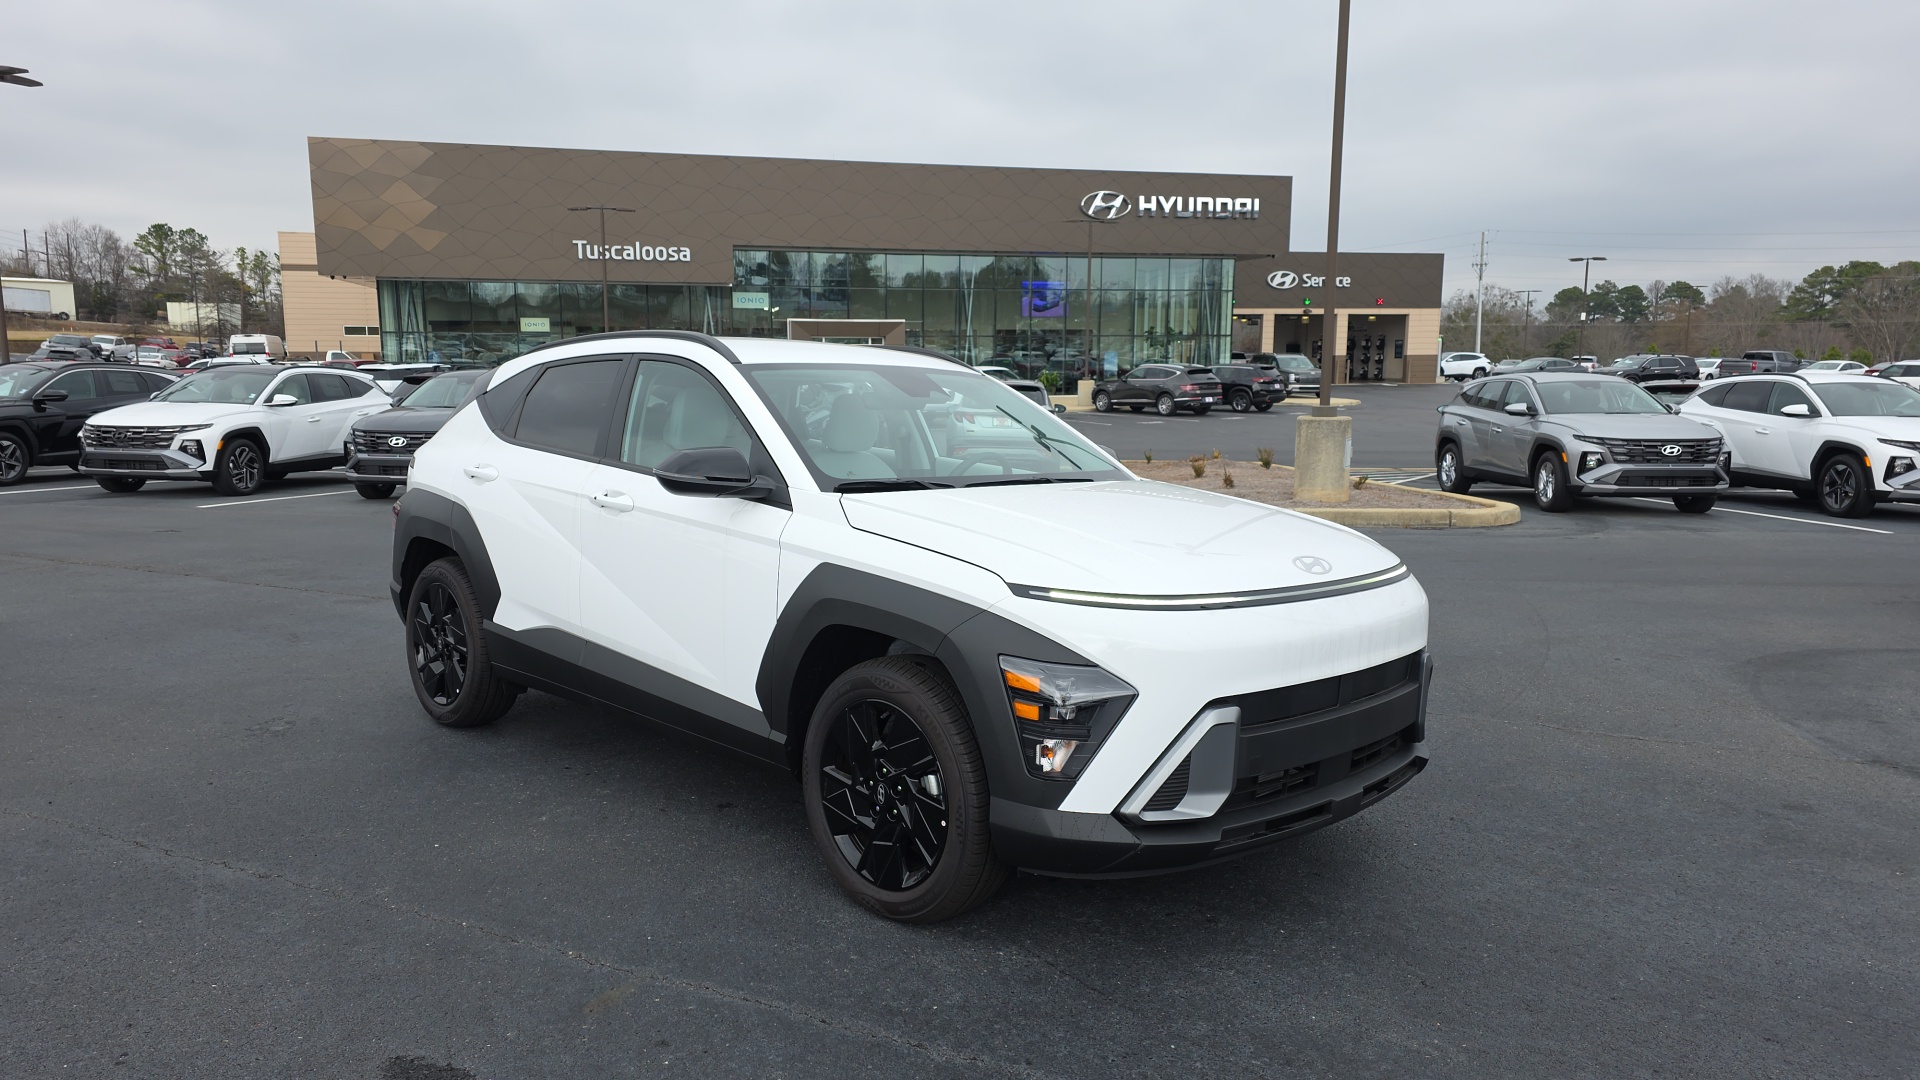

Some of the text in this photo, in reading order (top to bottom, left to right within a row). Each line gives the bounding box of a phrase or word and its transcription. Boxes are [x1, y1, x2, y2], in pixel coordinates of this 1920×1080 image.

[1138, 195, 1260, 219] HYUNDAI
[572, 240, 690, 262] Tuscaloosa
[1302, 273, 1351, 288] Serce
